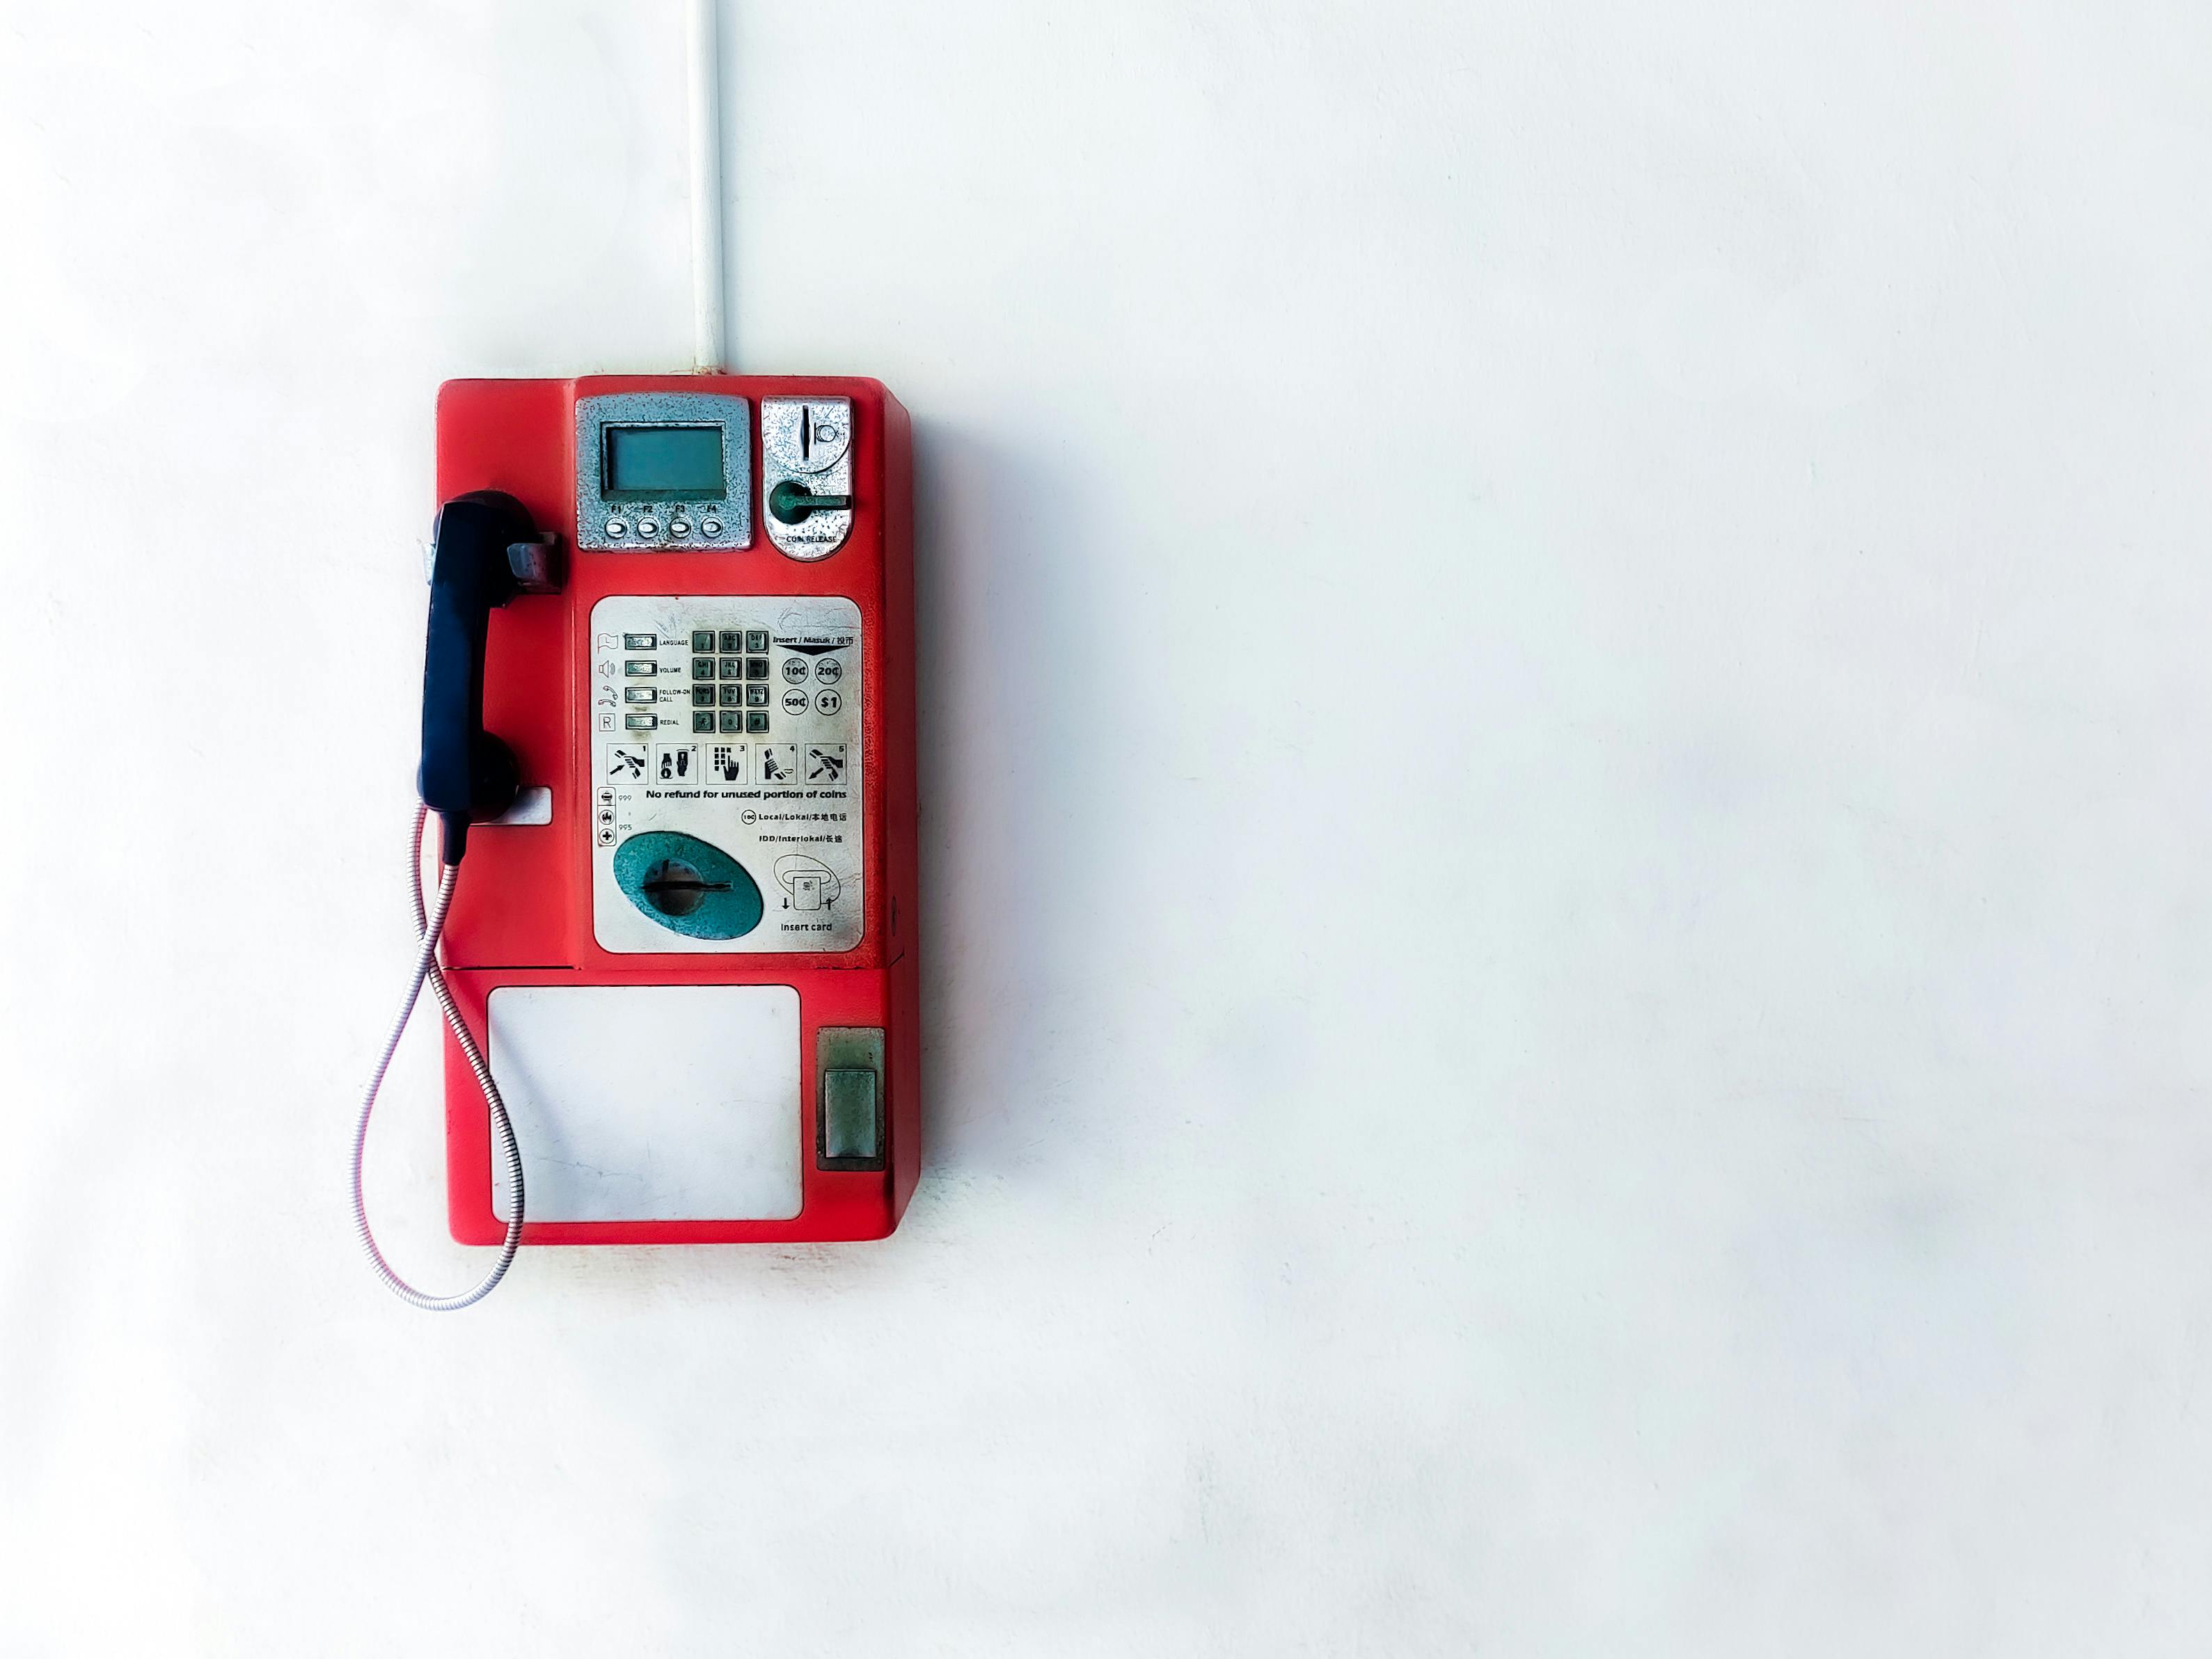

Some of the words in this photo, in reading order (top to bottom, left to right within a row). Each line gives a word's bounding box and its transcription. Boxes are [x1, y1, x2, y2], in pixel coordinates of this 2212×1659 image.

[786, 667, 806, 676] 10¢
[818, 667, 839, 676] 20¢
[785, 697, 806, 707] 50¢
[603, 716, 611, 729] R
[764, 791, 803, 800] portion
